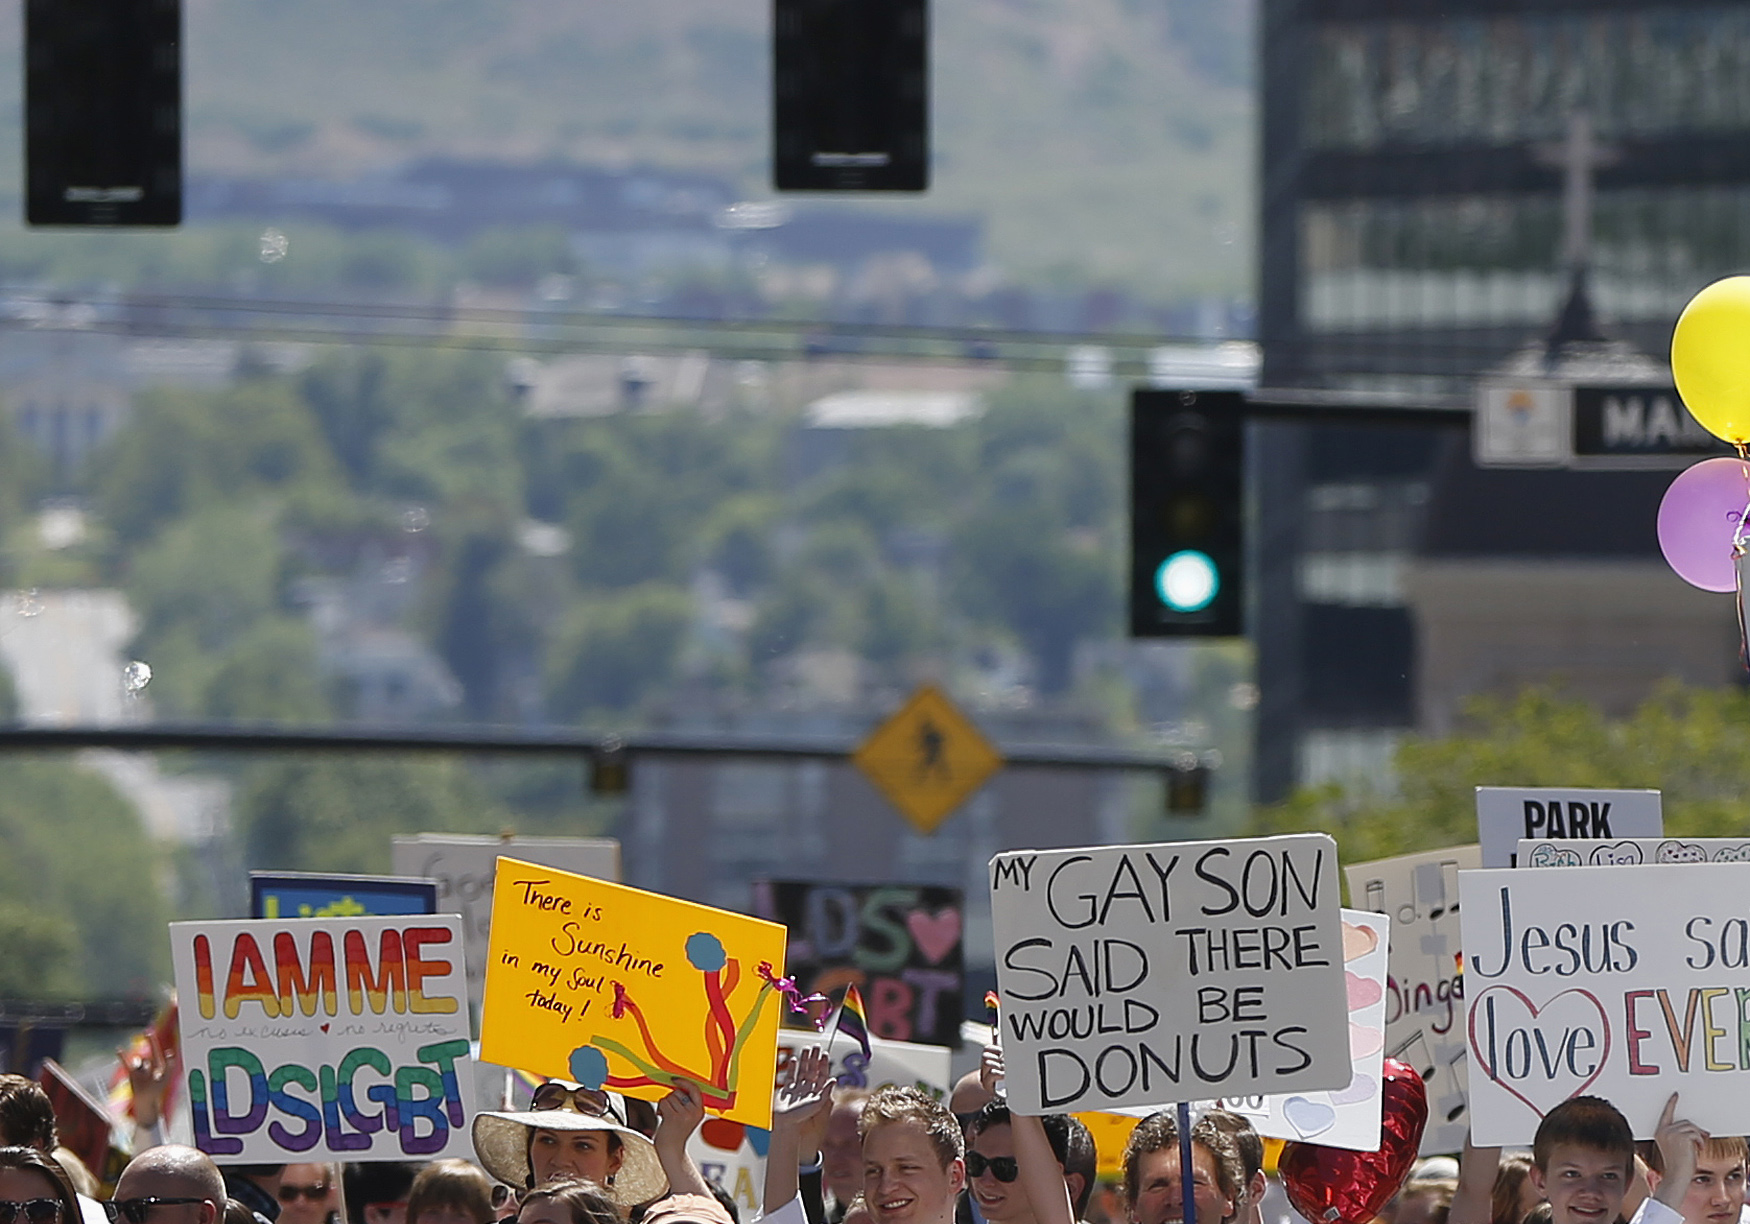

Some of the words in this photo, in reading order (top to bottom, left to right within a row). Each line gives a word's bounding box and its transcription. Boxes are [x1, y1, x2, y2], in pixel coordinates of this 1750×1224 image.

[1523, 801, 1613, 839] PARK
[513, 880, 571, 915] There
[583, 902, 603, 921] is
[994, 856, 1037, 891] MY
[1047, 854, 1180, 928] GAY
[1195, 847, 1322, 917] SON
[551, 922, 664, 978] Sunshine
[1471, 886, 1638, 977] Jesus
[501, 949, 519, 968] in
[531, 961, 562, 987] my
[1004, 938, 1149, 1000] SAID
[1175, 926, 1329, 976] THERE
[187, 1026, 227, 1040] no
[337, 1023, 366, 1036] no
[1009, 999, 1160, 1042] WOULD
[1198, 987, 1268, 1024] BE
[1486, 995, 1597, 1080] love
[1038, 1027, 1312, 1109] DONUTS
